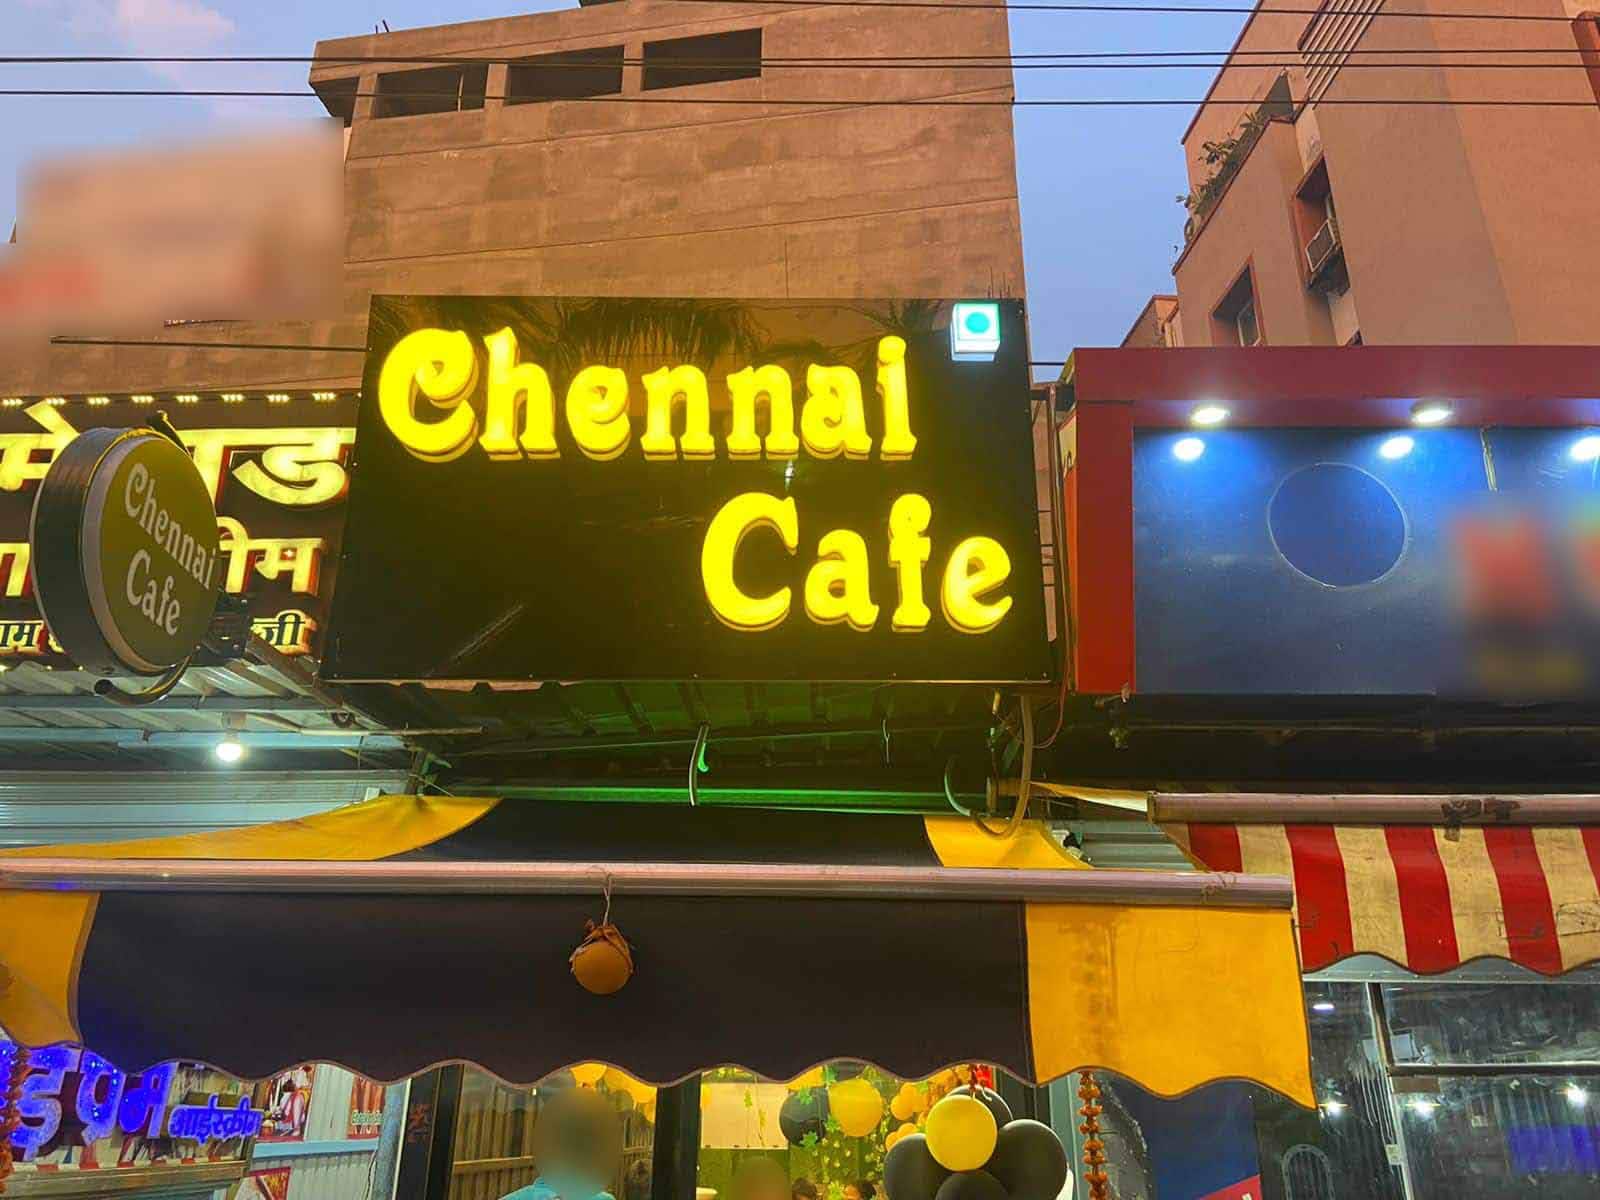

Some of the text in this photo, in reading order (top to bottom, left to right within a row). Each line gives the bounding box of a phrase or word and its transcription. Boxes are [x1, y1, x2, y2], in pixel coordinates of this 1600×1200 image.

[378, 326, 918, 463] Chennai
[124, 462, 217, 590] Chennai
[126, 548, 181, 636] Cafe
[701, 491, 1013, 634] Cafe
